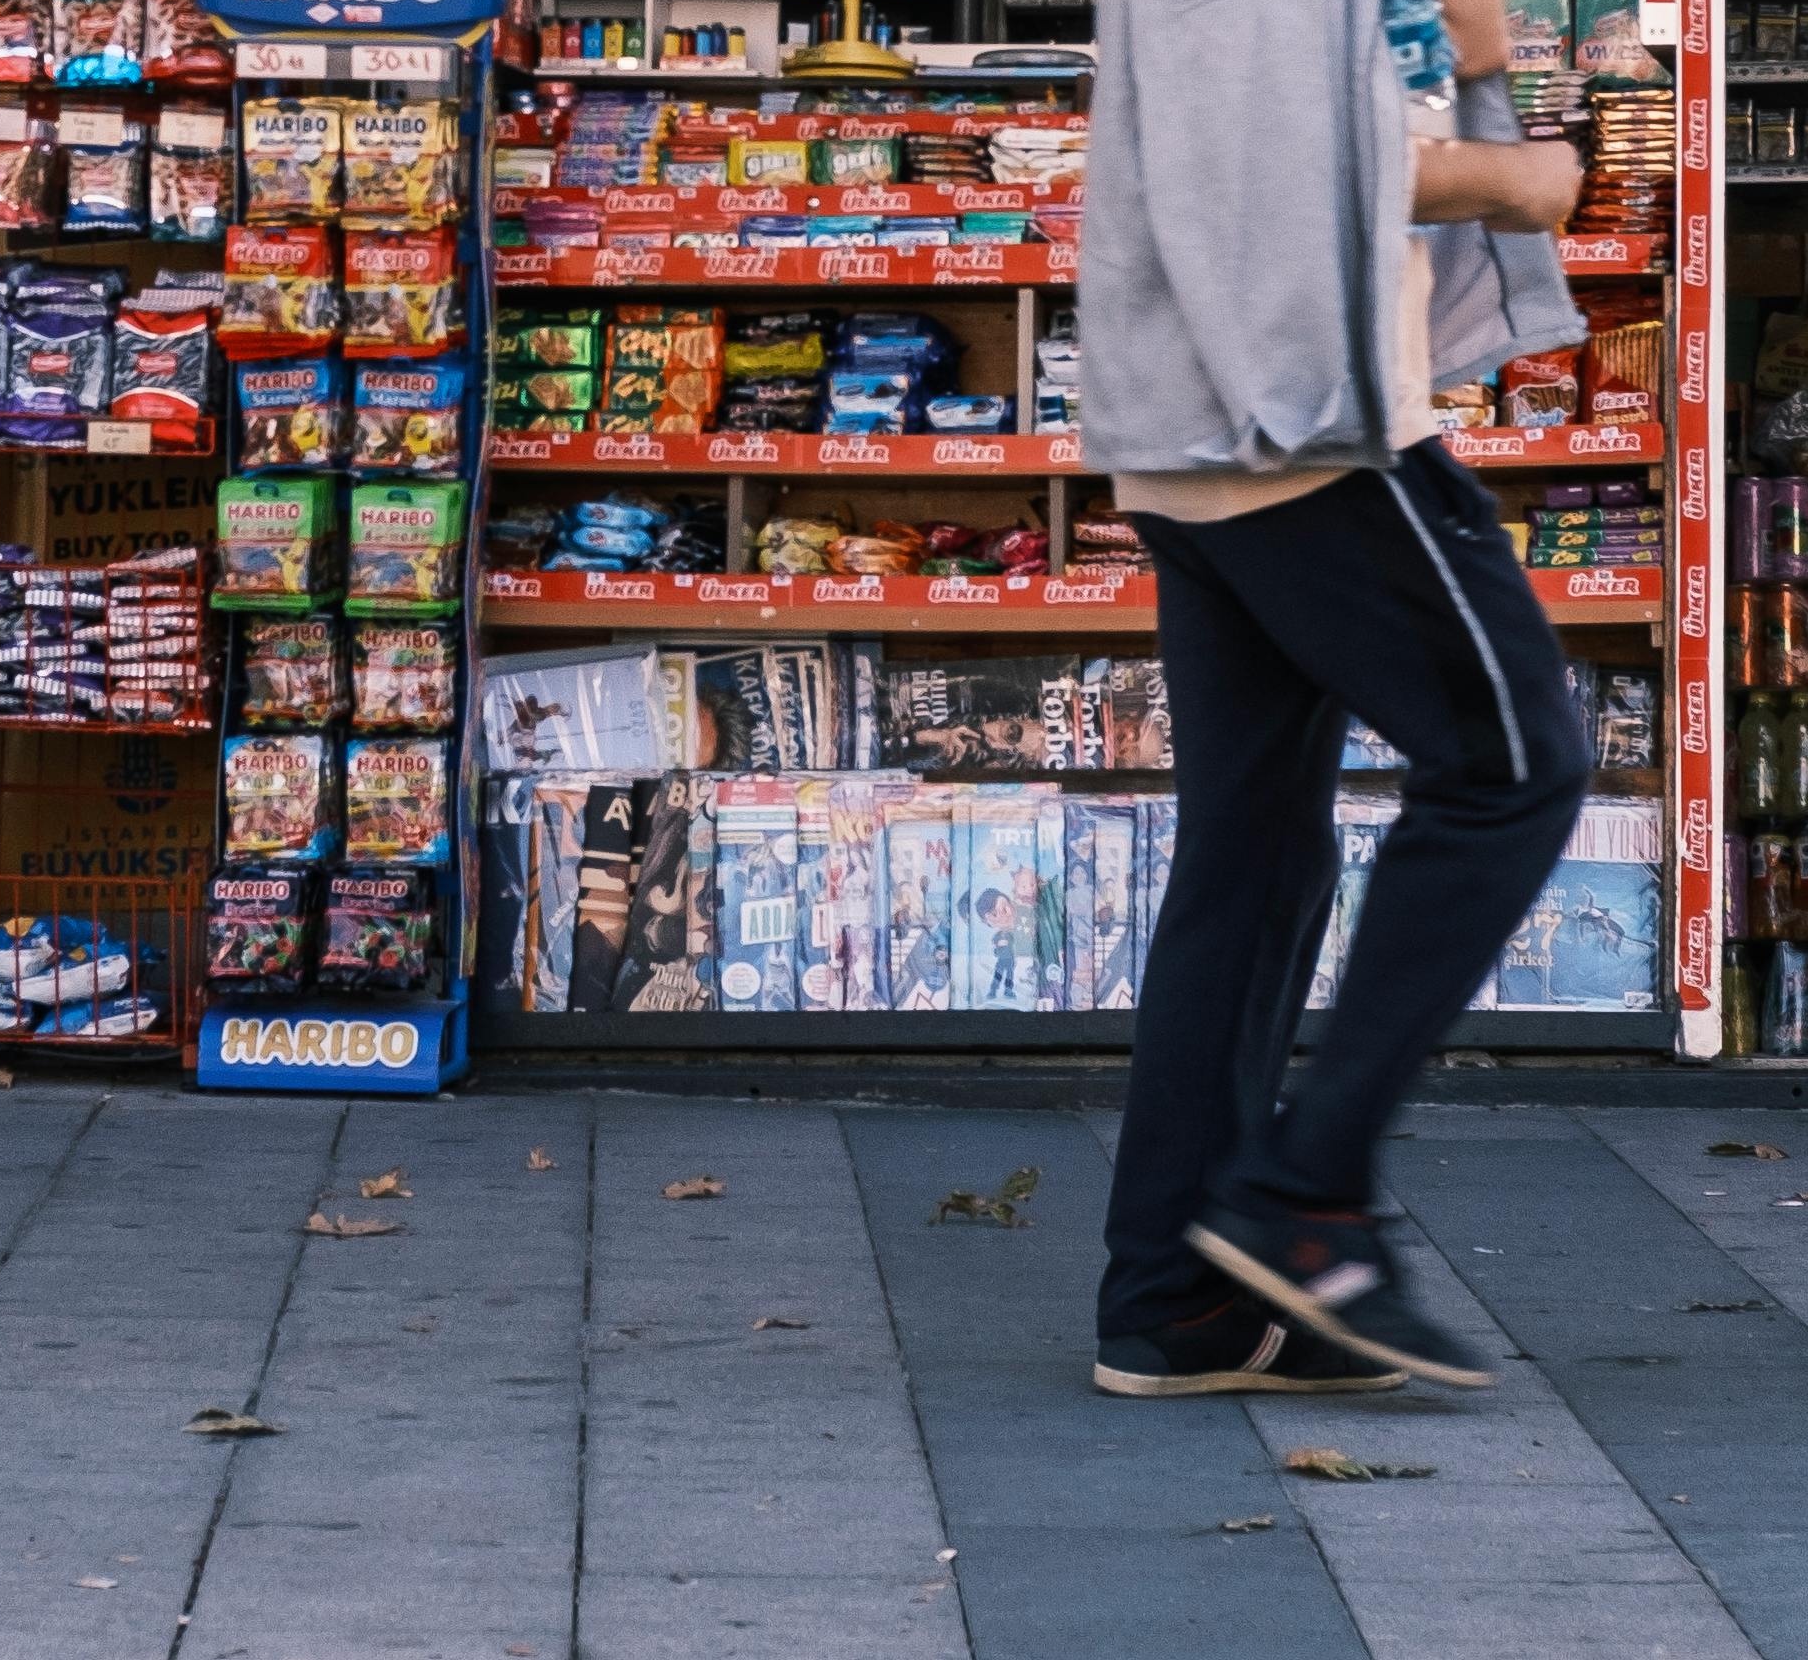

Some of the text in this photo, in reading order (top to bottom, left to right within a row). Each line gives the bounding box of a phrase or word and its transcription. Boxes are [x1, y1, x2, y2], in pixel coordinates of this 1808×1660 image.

[255, 116, 329, 133] HARIBO
[355, 117, 427, 134] HARIBO
[604, 191, 675, 213] ÜLKER
[840, 190, 910, 211] ÜLKER
[234, 244, 309, 263] HARIBO
[353, 250, 429, 271] HARIBO
[493, 250, 551, 271] LKER
[245, 369, 316, 391] HARIBO
[363, 371, 437, 392] HARIBO
[595, 437, 664, 461] ÜLKER
[708, 437, 778, 461] ÜLKER
[819, 439, 889, 463] ÜLKER
[933, 439, 1004, 463] ÜLKER
[1453, 431, 1641, 456] ÜLKER ÜLKER
[227, 503, 301, 520] HARIBO
[360, 508, 436, 526] HARIBO
[585, 578, 1115, 602] ÜLKER ÜLKER ÜLKER ÜLKER ÜLKER
[1568, 573, 1639, 596] ÜLKER
[1041, 679, 1073, 770] Forbe
[235, 755, 308, 772] HARIBO
[357, 756, 429, 772] HARIBO
[990, 827, 1033, 847] TRT
[214, 880, 290, 900] HARIBO
[332, 879, 408, 898] HARIBO
[221, 1018, 418, 1067] HARIBO
